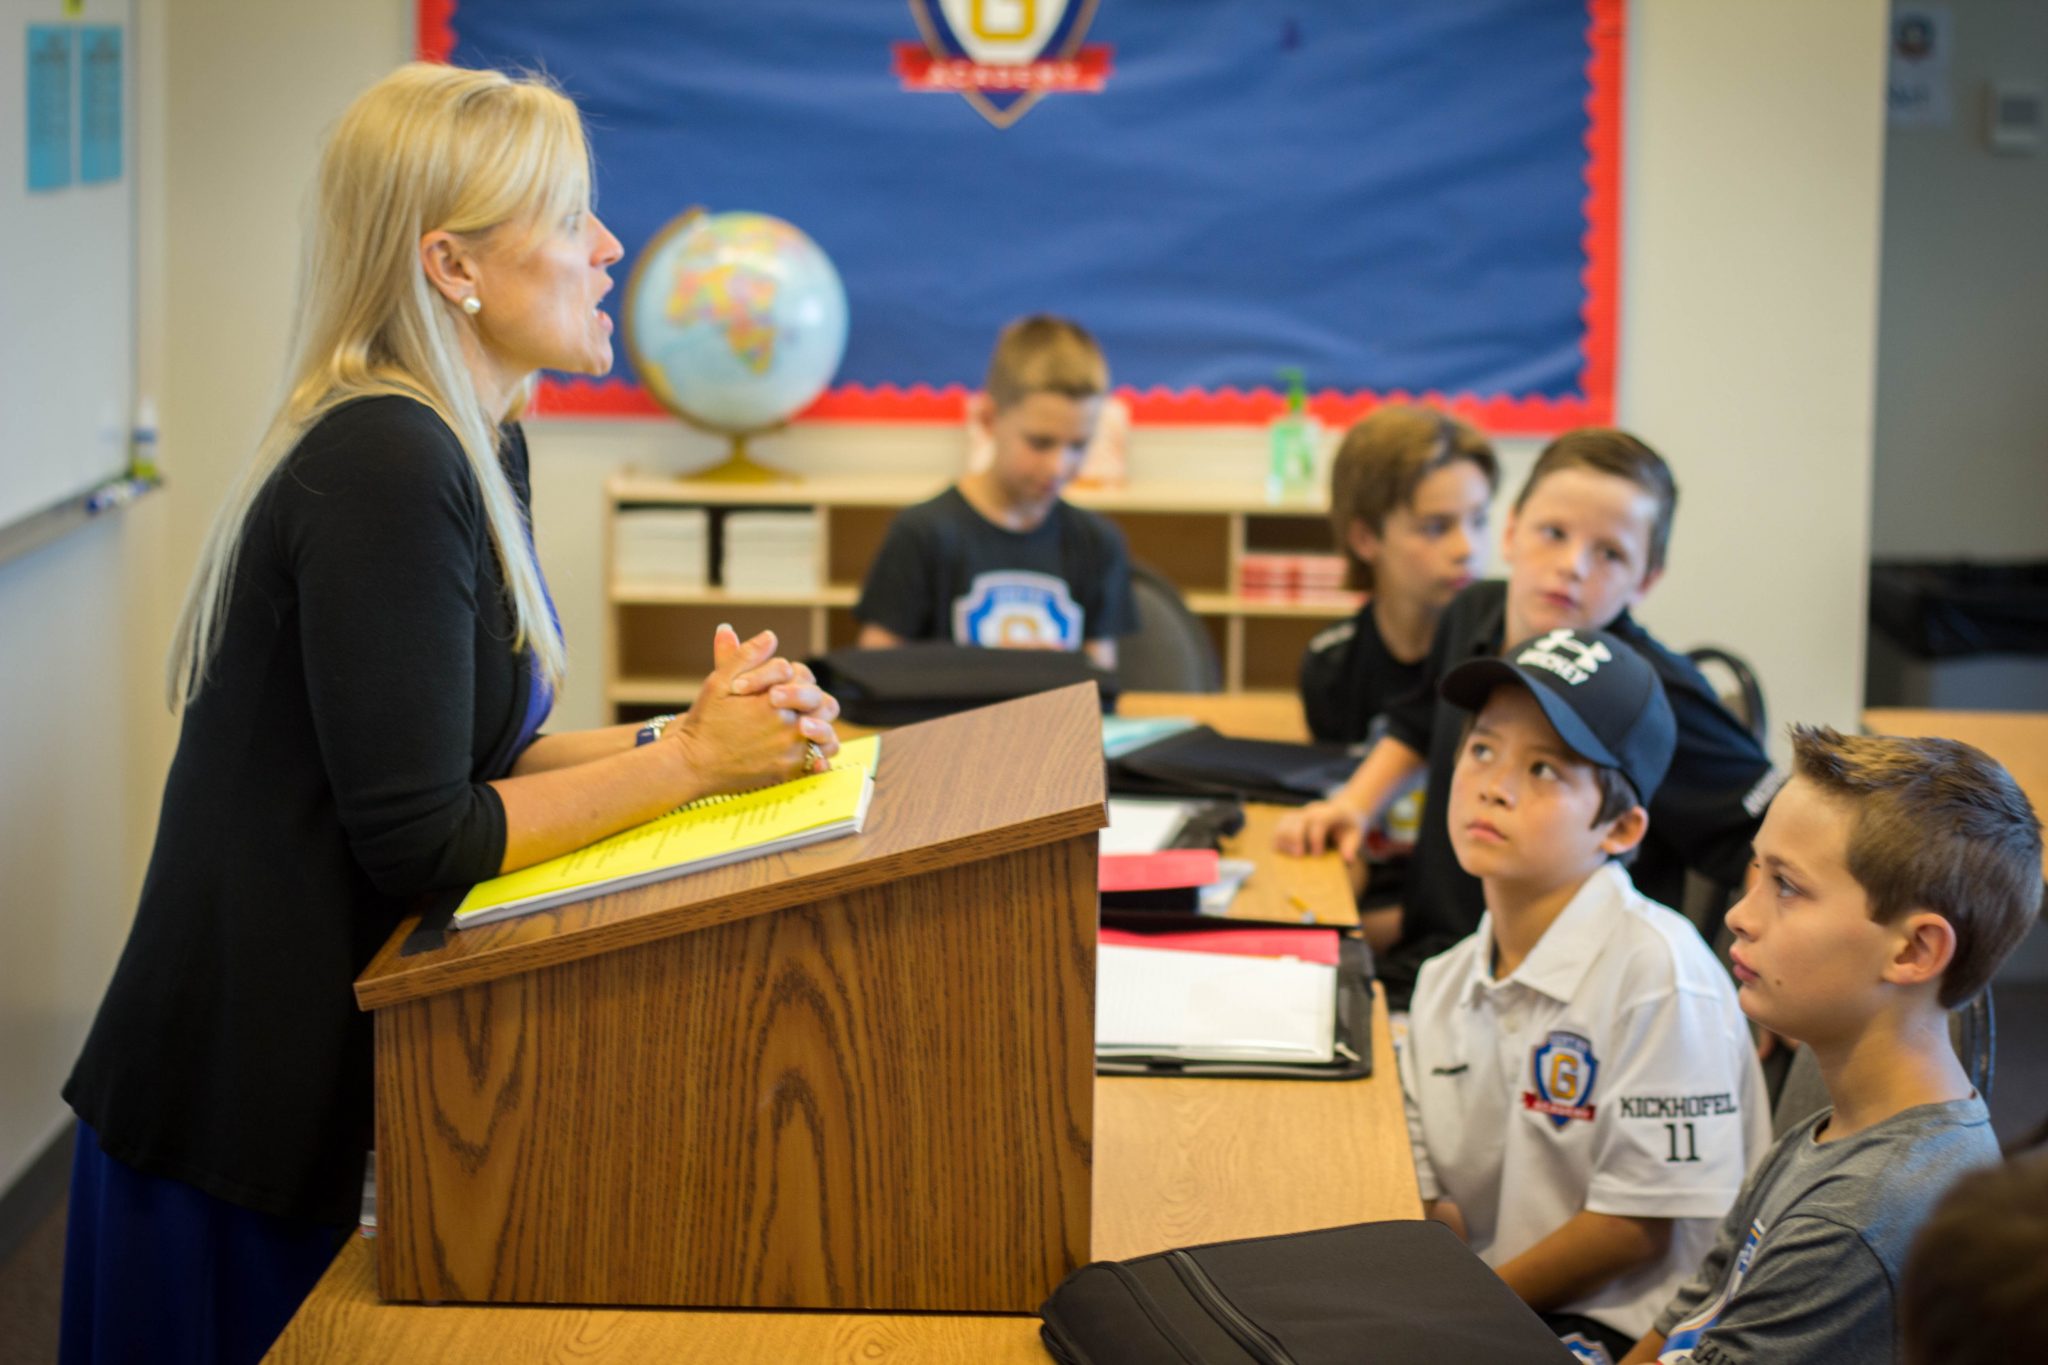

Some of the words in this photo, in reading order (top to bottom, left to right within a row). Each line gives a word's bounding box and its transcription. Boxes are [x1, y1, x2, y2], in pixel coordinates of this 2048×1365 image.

[1551, 1053, 1578, 1100] G
[1620, 1093, 1737, 1118] KICKHOFEL
[1664, 1123, 1701, 1162] 11
